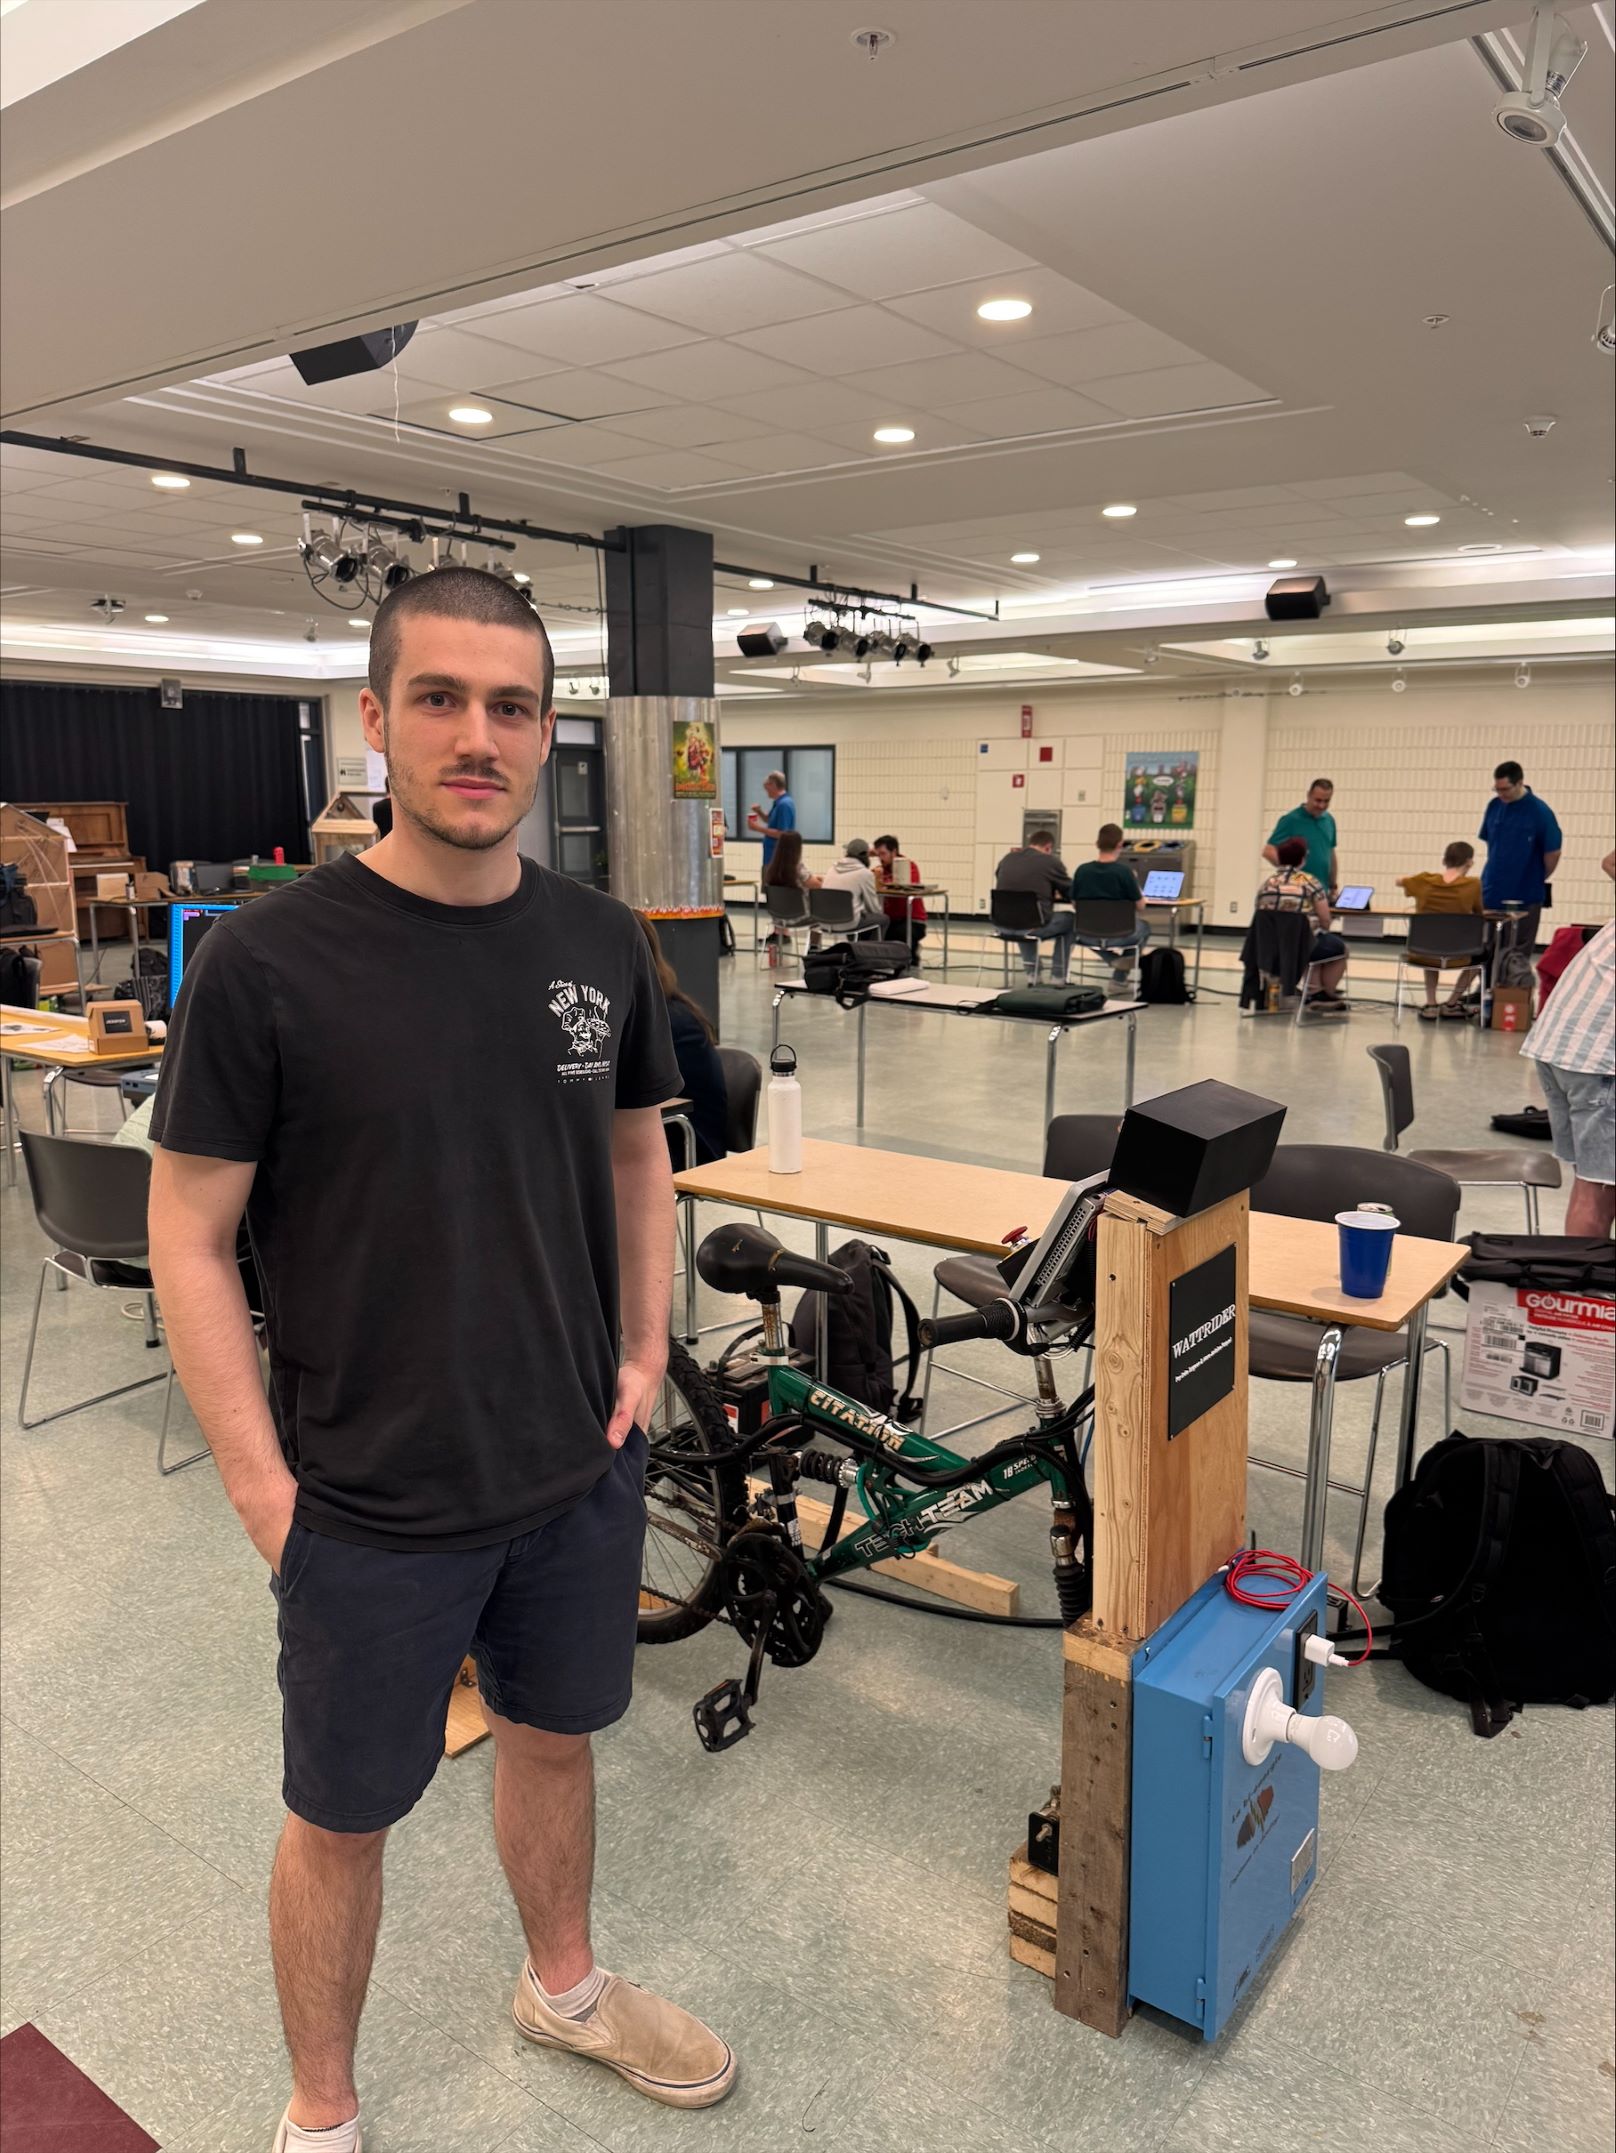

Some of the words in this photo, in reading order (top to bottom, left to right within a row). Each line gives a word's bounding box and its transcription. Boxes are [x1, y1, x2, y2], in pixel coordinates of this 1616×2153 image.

[548, 984, 579, 1018] NEW
[580, 984, 611, 1015] YORK
[1172, 1303, 1237, 1360] WATTRIDER
